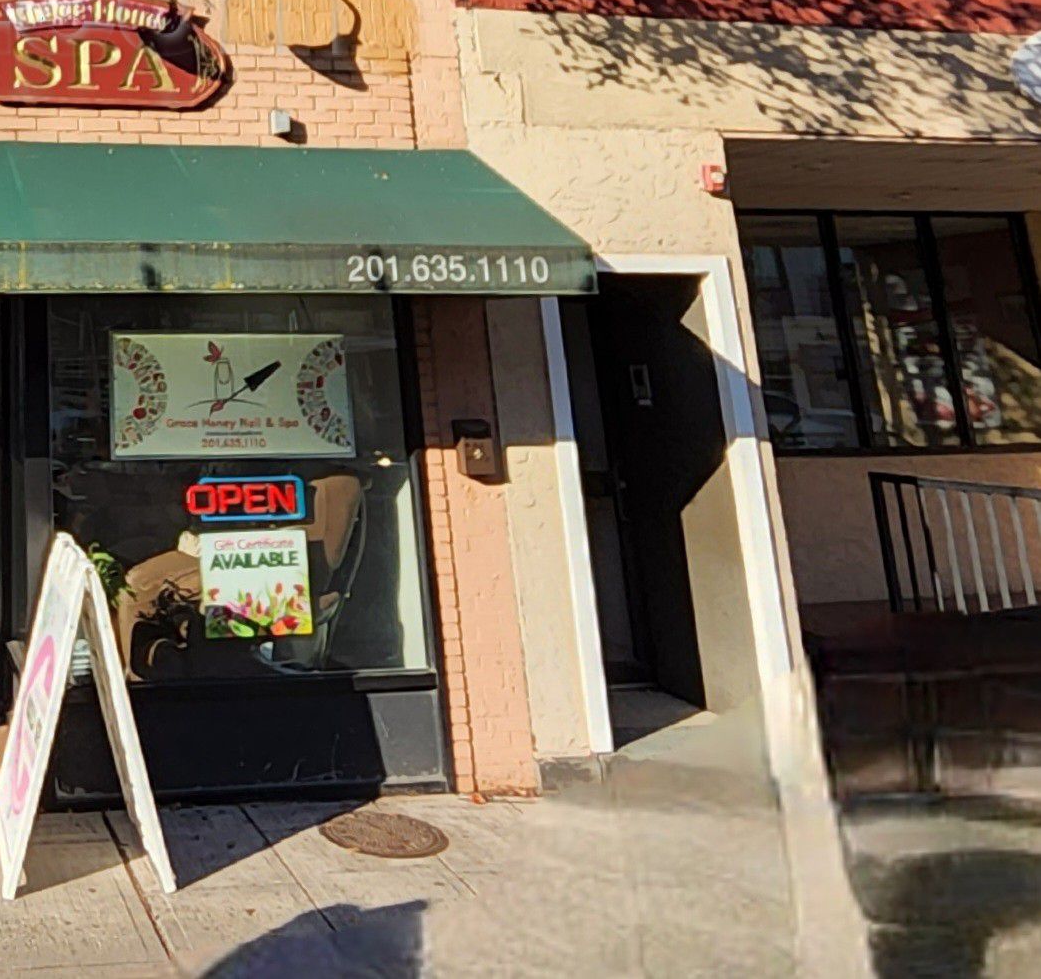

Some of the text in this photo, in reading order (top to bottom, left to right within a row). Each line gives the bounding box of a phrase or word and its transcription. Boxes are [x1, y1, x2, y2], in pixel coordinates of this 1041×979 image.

[14, 34, 181, 92] SPA
[347, 254, 549, 283] 201.635.1110
[186, 484, 297, 515] OPEN
[210, 551, 299, 571] AVAILABLE
